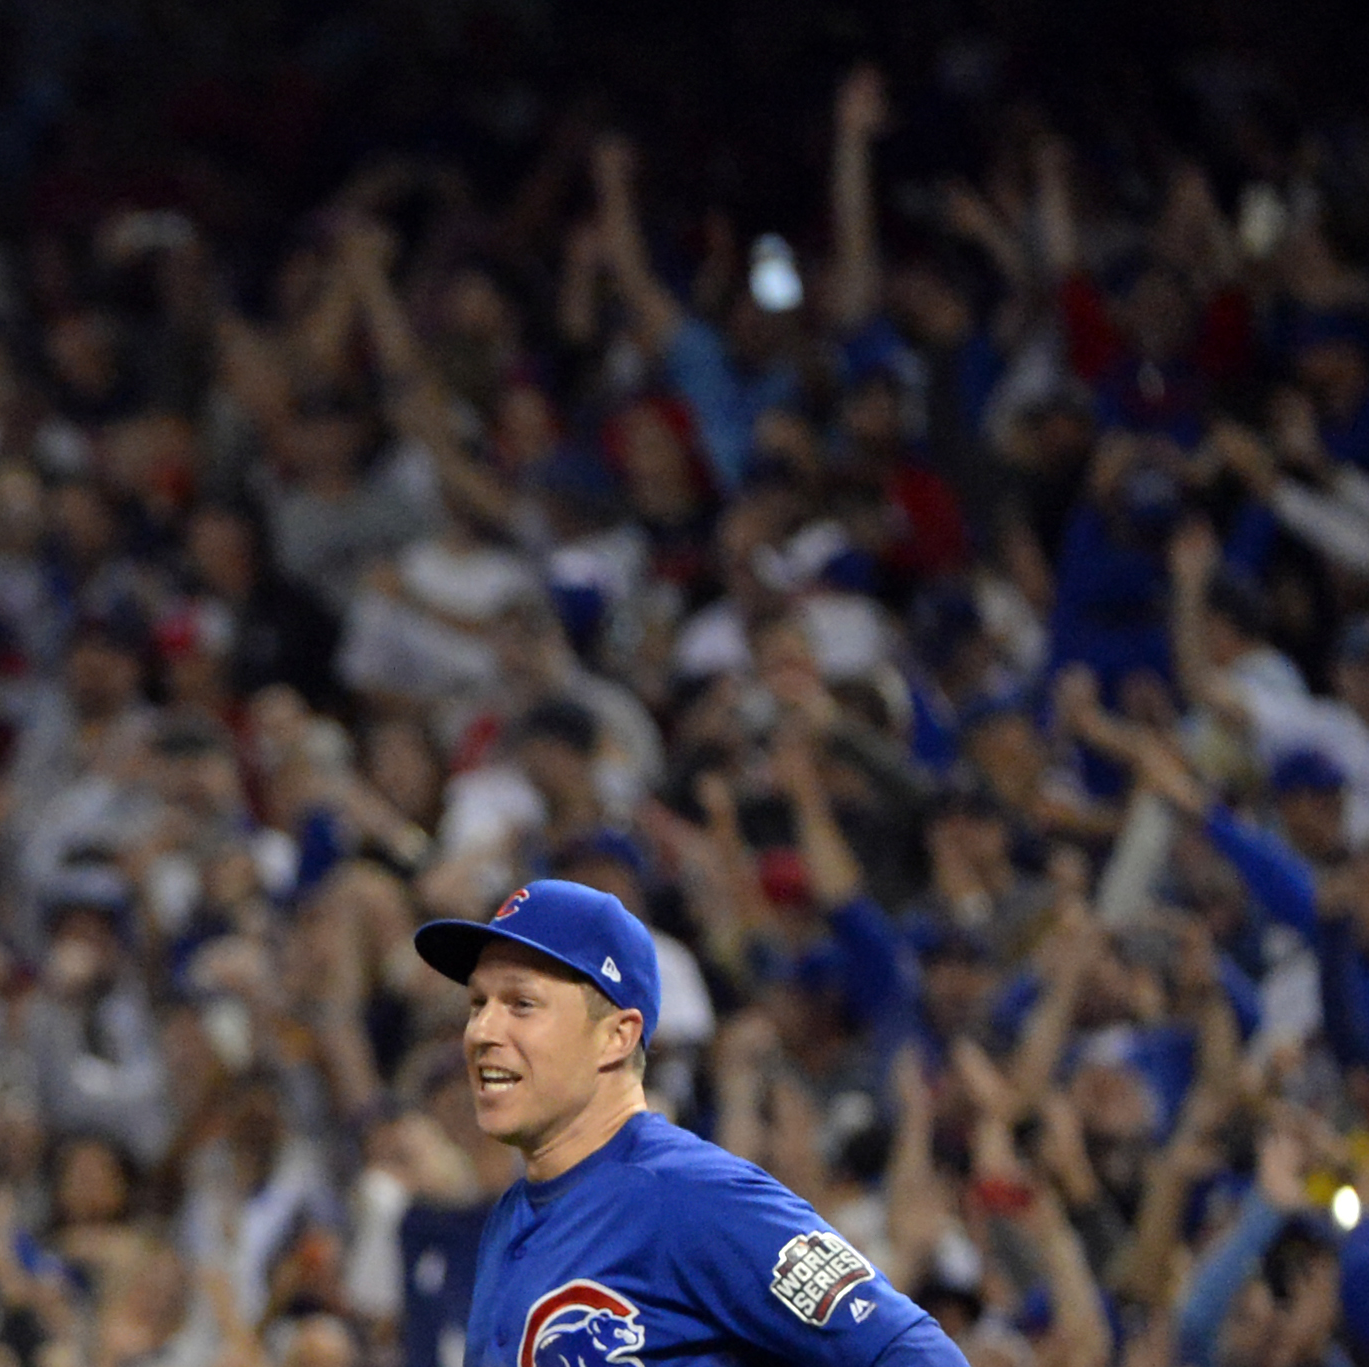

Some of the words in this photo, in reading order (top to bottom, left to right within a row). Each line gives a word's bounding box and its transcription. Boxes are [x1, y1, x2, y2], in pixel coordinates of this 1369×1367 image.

[495, 888, 530, 920] C
[776, 1239, 844, 1298] WORLD
[793, 1250, 863, 1317] SERIES
